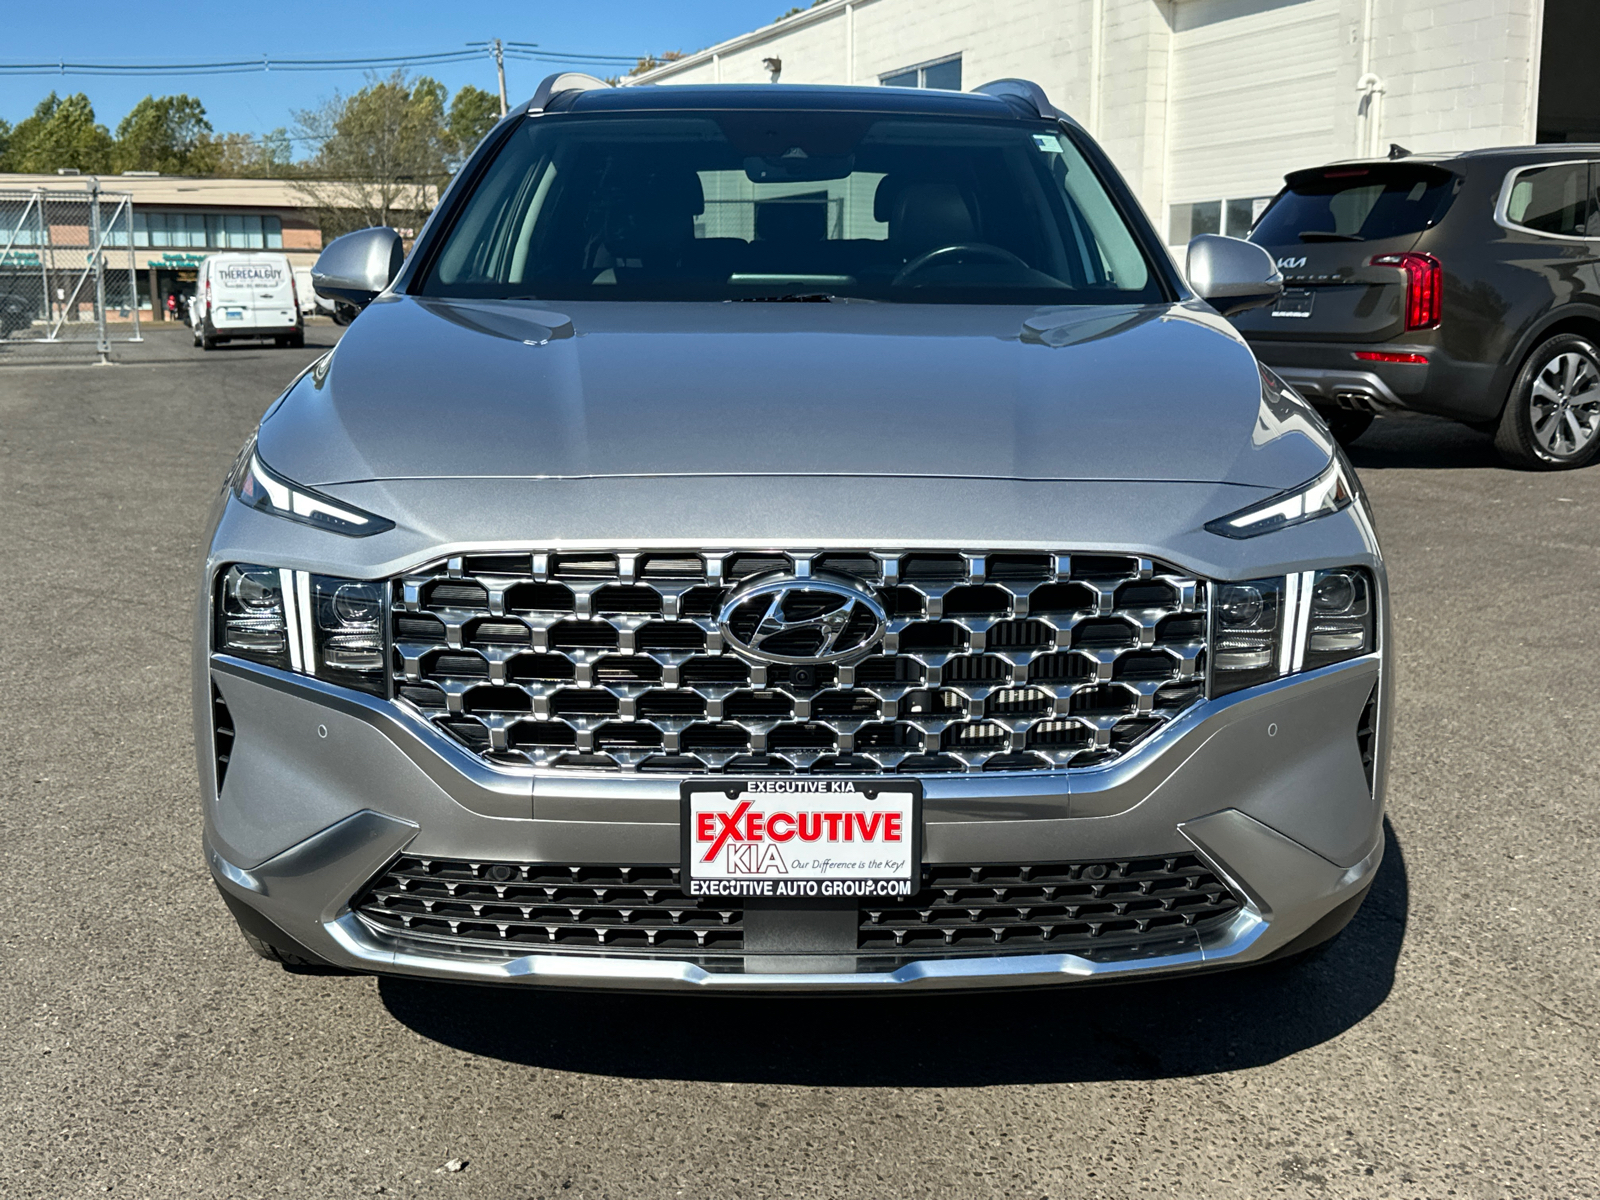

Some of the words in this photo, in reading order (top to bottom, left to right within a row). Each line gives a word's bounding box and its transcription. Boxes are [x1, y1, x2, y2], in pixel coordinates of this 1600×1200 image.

[1277, 257, 1307, 268] KIA
[747, 781, 827, 793] EXECUTIVE
[831, 781, 855, 793] KIA
[696, 800, 903, 863] EXECUTIVE
[727, 844, 788, 874] KIA
[791, 859, 809, 869] Our
[812, 859, 856, 873] Difference
[858, 859, 866, 869] is
[868, 859, 882, 869] the
[884, 859, 905, 873] Key!
[691, 880, 775, 895] EXECUTIVE
[777, 880, 817, 895] AUTO
[821, 880, 911, 895] GROUP.COM
